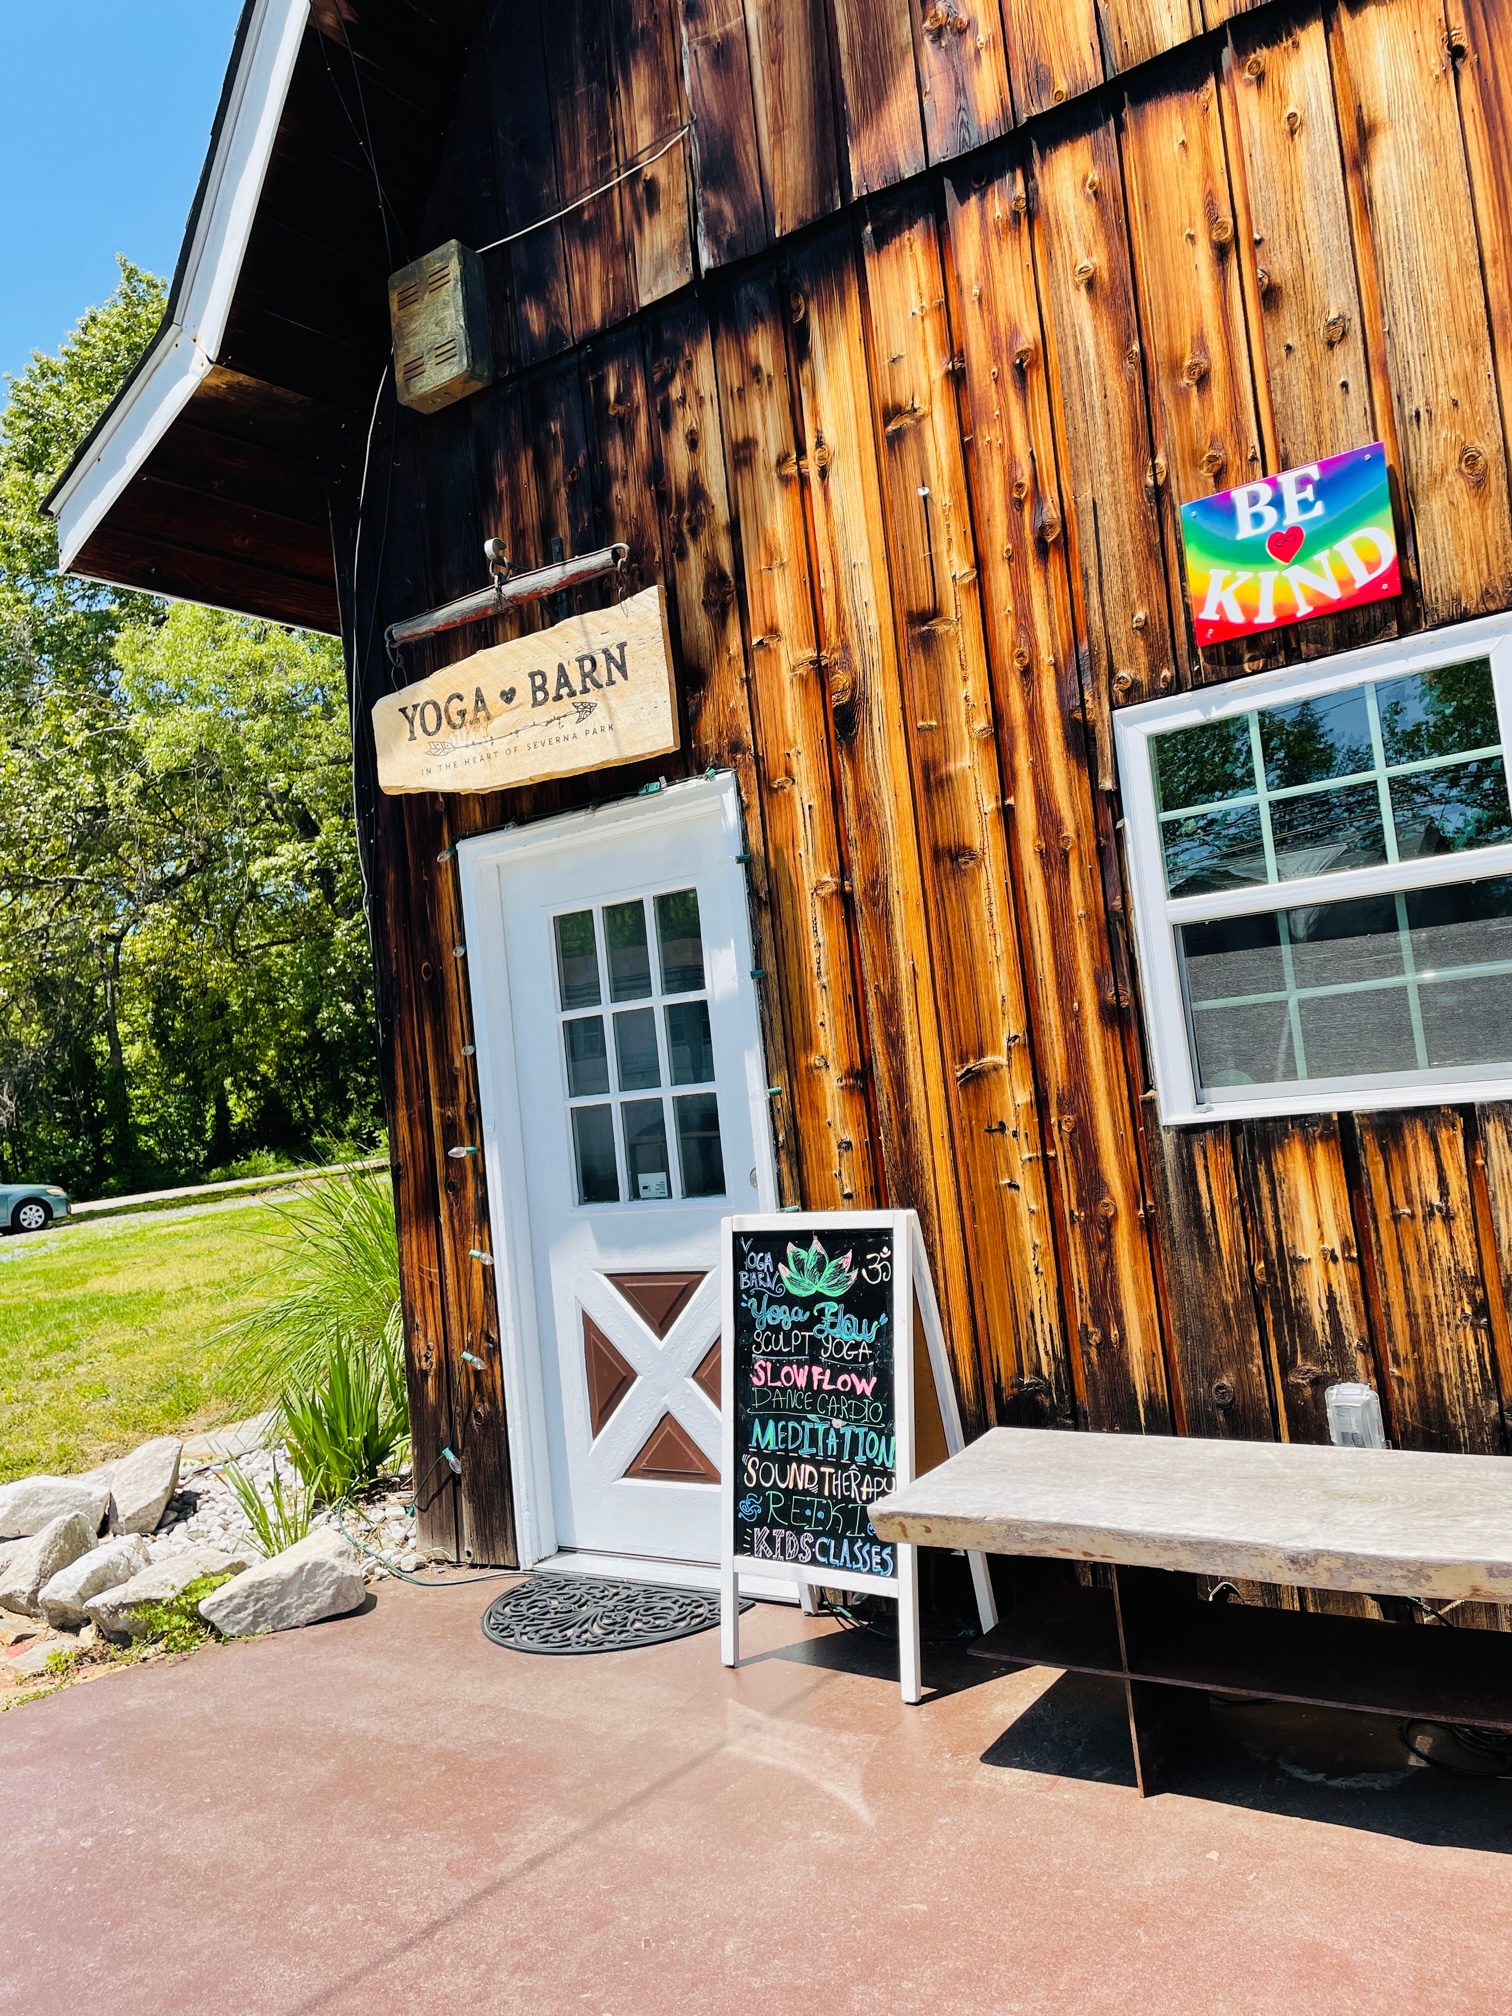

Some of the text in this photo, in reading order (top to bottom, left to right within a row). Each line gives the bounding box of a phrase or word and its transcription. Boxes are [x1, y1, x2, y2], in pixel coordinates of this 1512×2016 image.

[1230, 464, 1324, 541] BE
[1198, 527, 1395, 624] KIND
[398, 641, 630, 742] YOGA BARN
[420, 723, 615, 777] IN THE HEART OF SEVERNA PARK
[740, 1236, 774, 1273] YOGA
[738, 1271, 780, 1290] BARN
[748, 1294, 880, 1343] Yoga Flow
[752, 1330, 873, 1362] SCULPT YOGA
[751, 1360, 878, 1397] SLOW FLOW
[752, 1387, 883, 1423] DANCE CARDIO
[748, 1418, 896, 1468] MEDITATION
[744, 1457, 818, 1491] SOUND
[766, 1491, 869, 1537] REIKI
[754, 1526, 894, 1577] KIDS CLASSES
